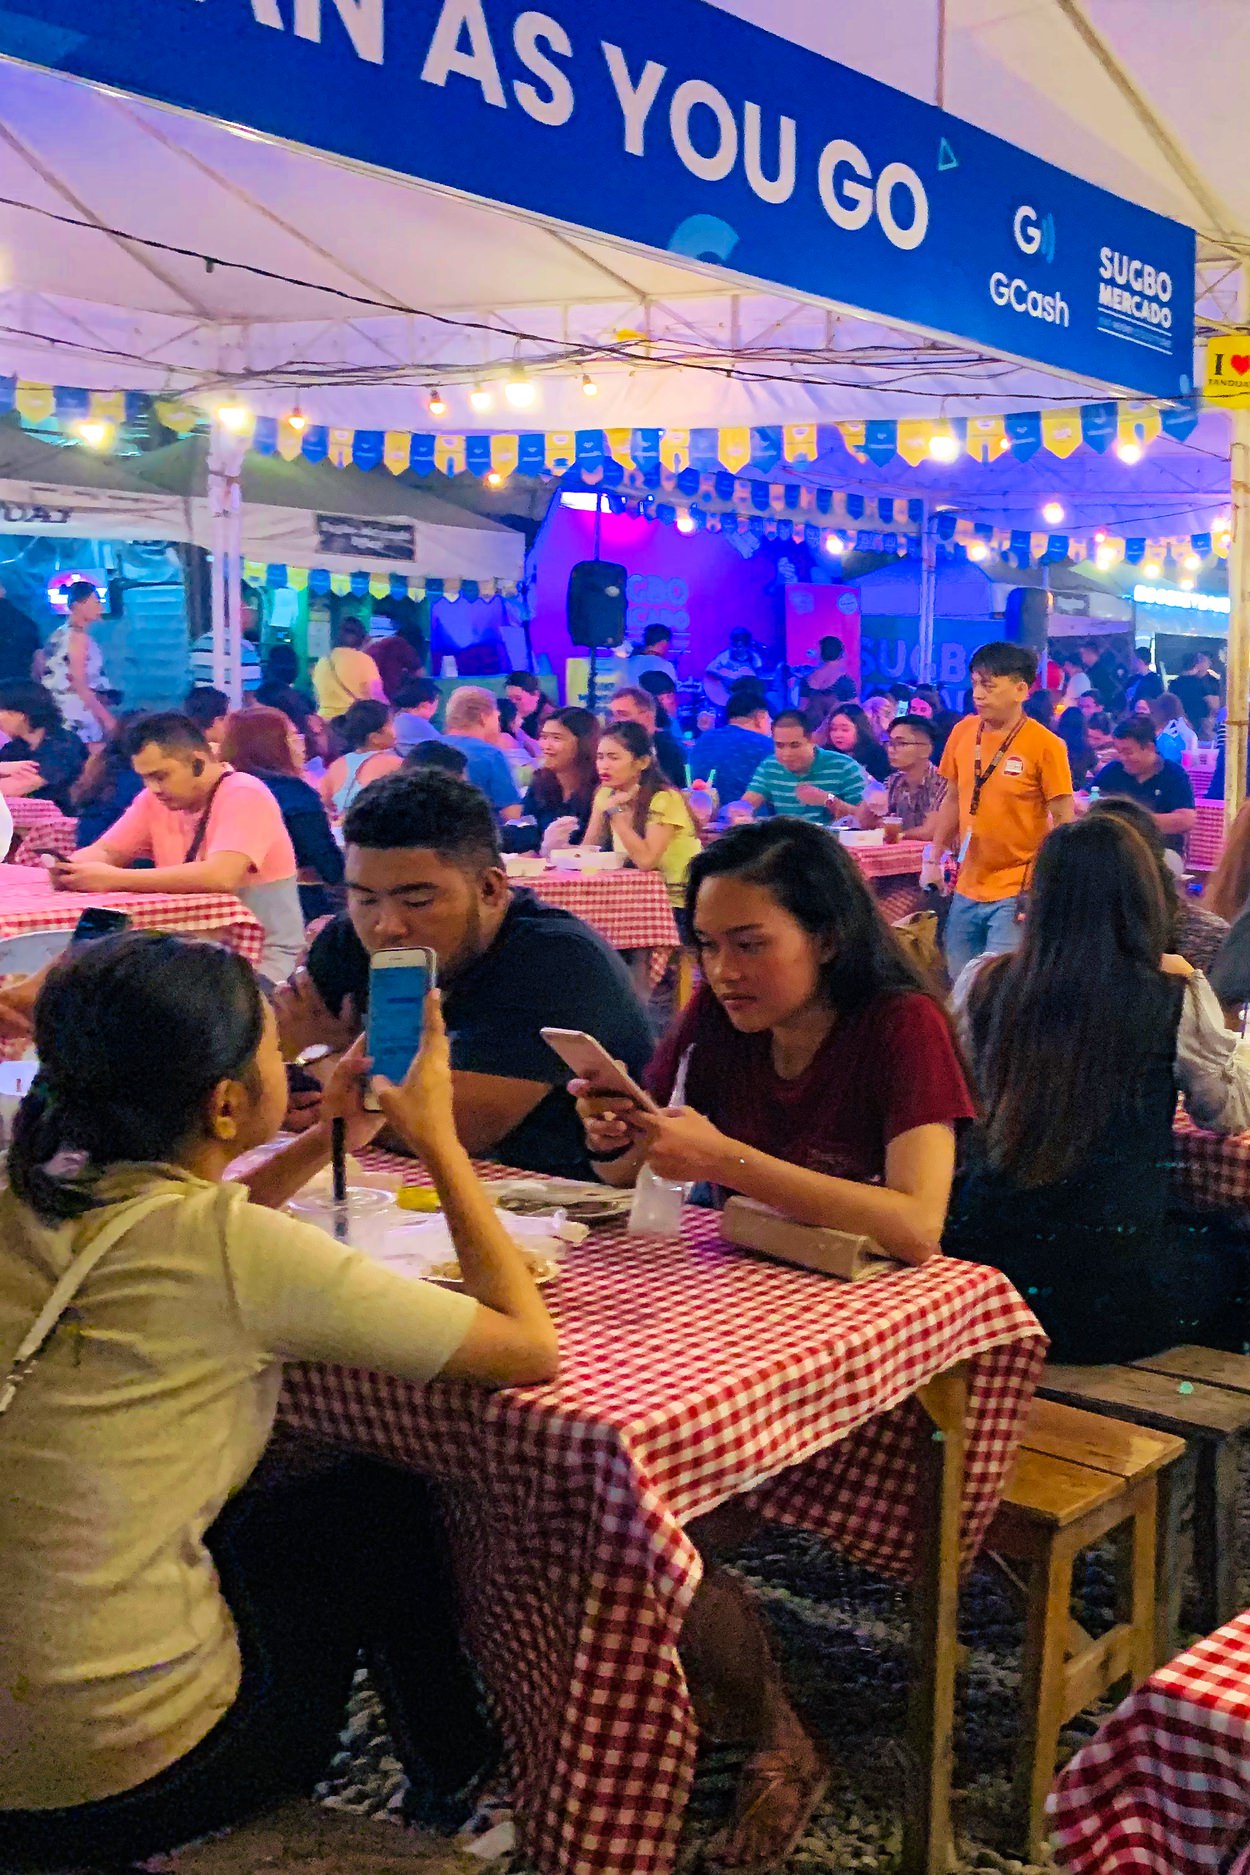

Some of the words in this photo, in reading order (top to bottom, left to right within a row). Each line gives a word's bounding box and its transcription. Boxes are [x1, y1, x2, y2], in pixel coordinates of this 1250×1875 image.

[421, 0, 574, 126] AS
[601, 40, 796, 204] YOU
[818, 139, 929, 250] GO
[1013, 205, 1041, 255] G
[989, 271, 1069, 328] GCash
[1099, 247, 1172, 302] SUGBO
[1098, 282, 1172, 328] MERCADO
[1214, 353, 1224, 376] I
